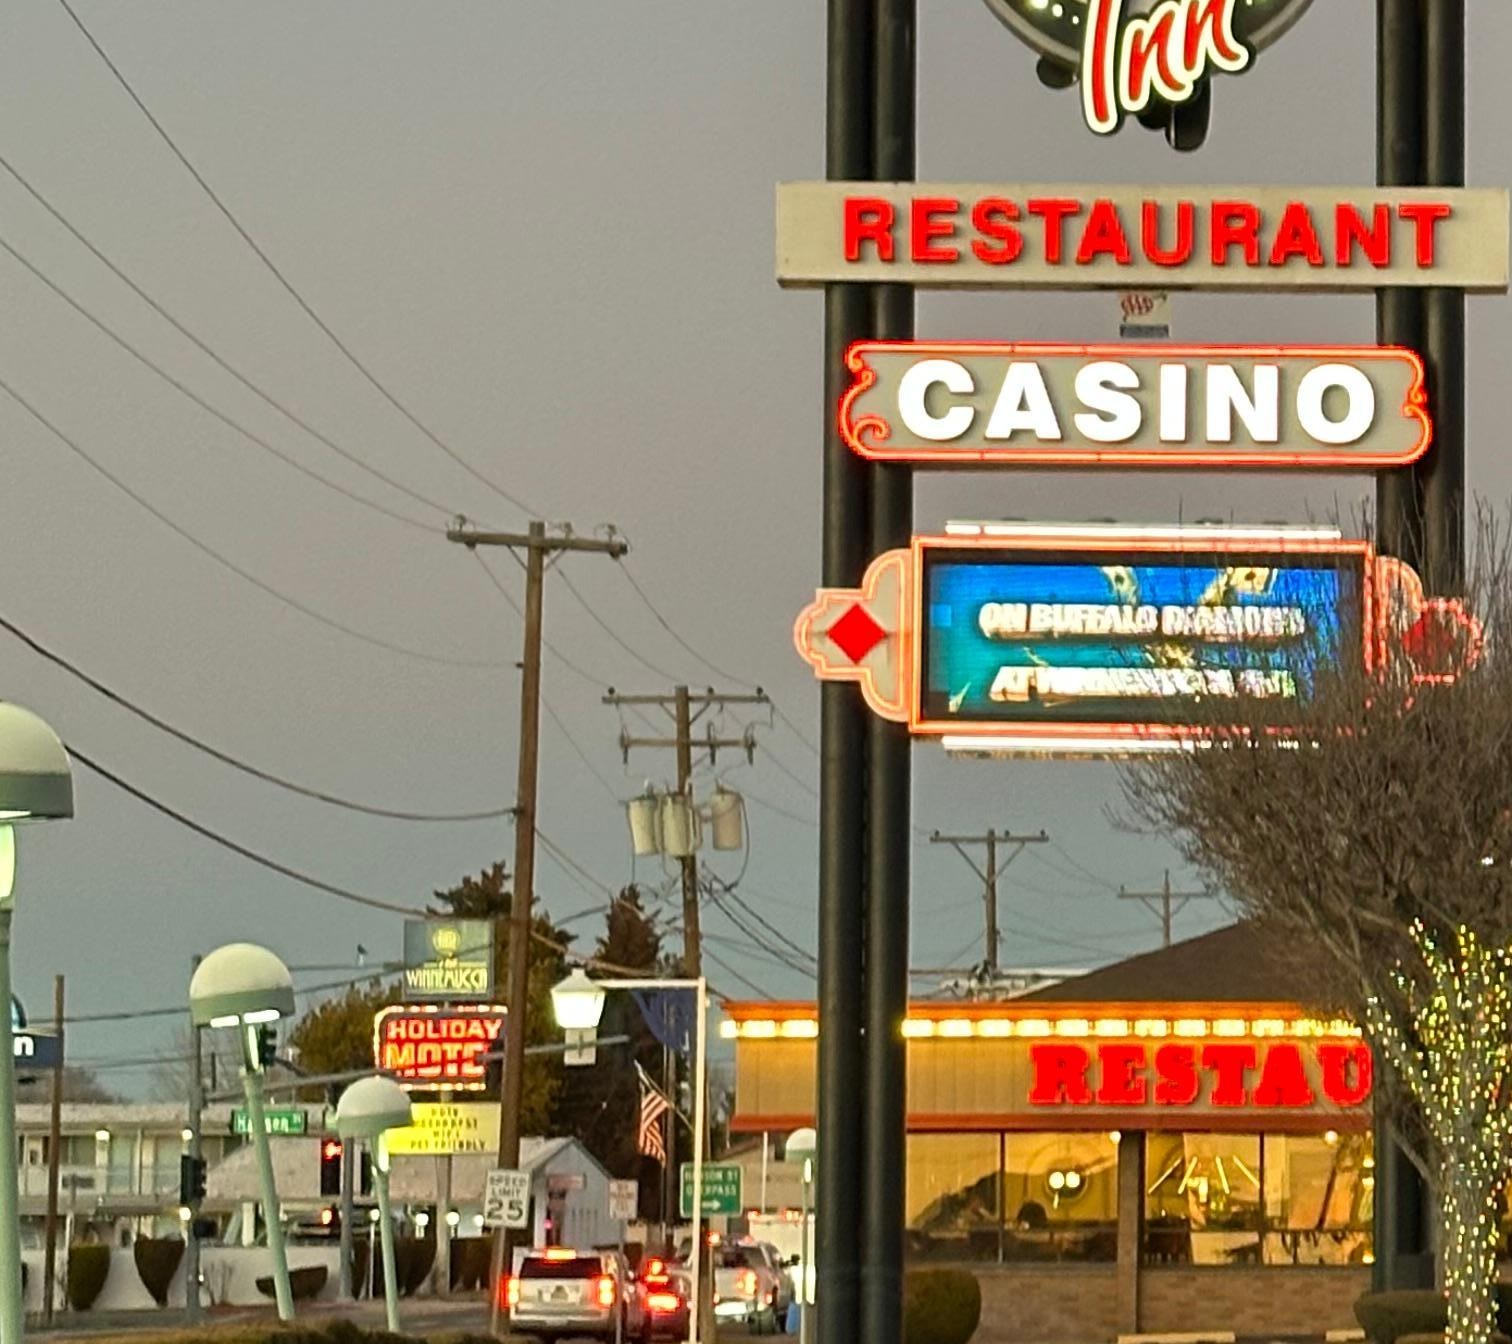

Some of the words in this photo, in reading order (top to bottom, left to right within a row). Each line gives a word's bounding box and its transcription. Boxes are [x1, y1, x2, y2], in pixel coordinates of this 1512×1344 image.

[843, 197, 1452, 267] RESTAURANT
[897, 358, 1376, 445] CASINO
[979, 602, 1027, 633] ON
[1030, 604, 1158, 635] BUFFALO
[387, 1019, 502, 1040] HOLIDAY
[383, 1042, 488, 1077] MOTE
[489, 1176, 527, 1187] SPEED
[491, 1188, 521, 1198] LIMIT
[486, 1198, 524, 1221] 25
